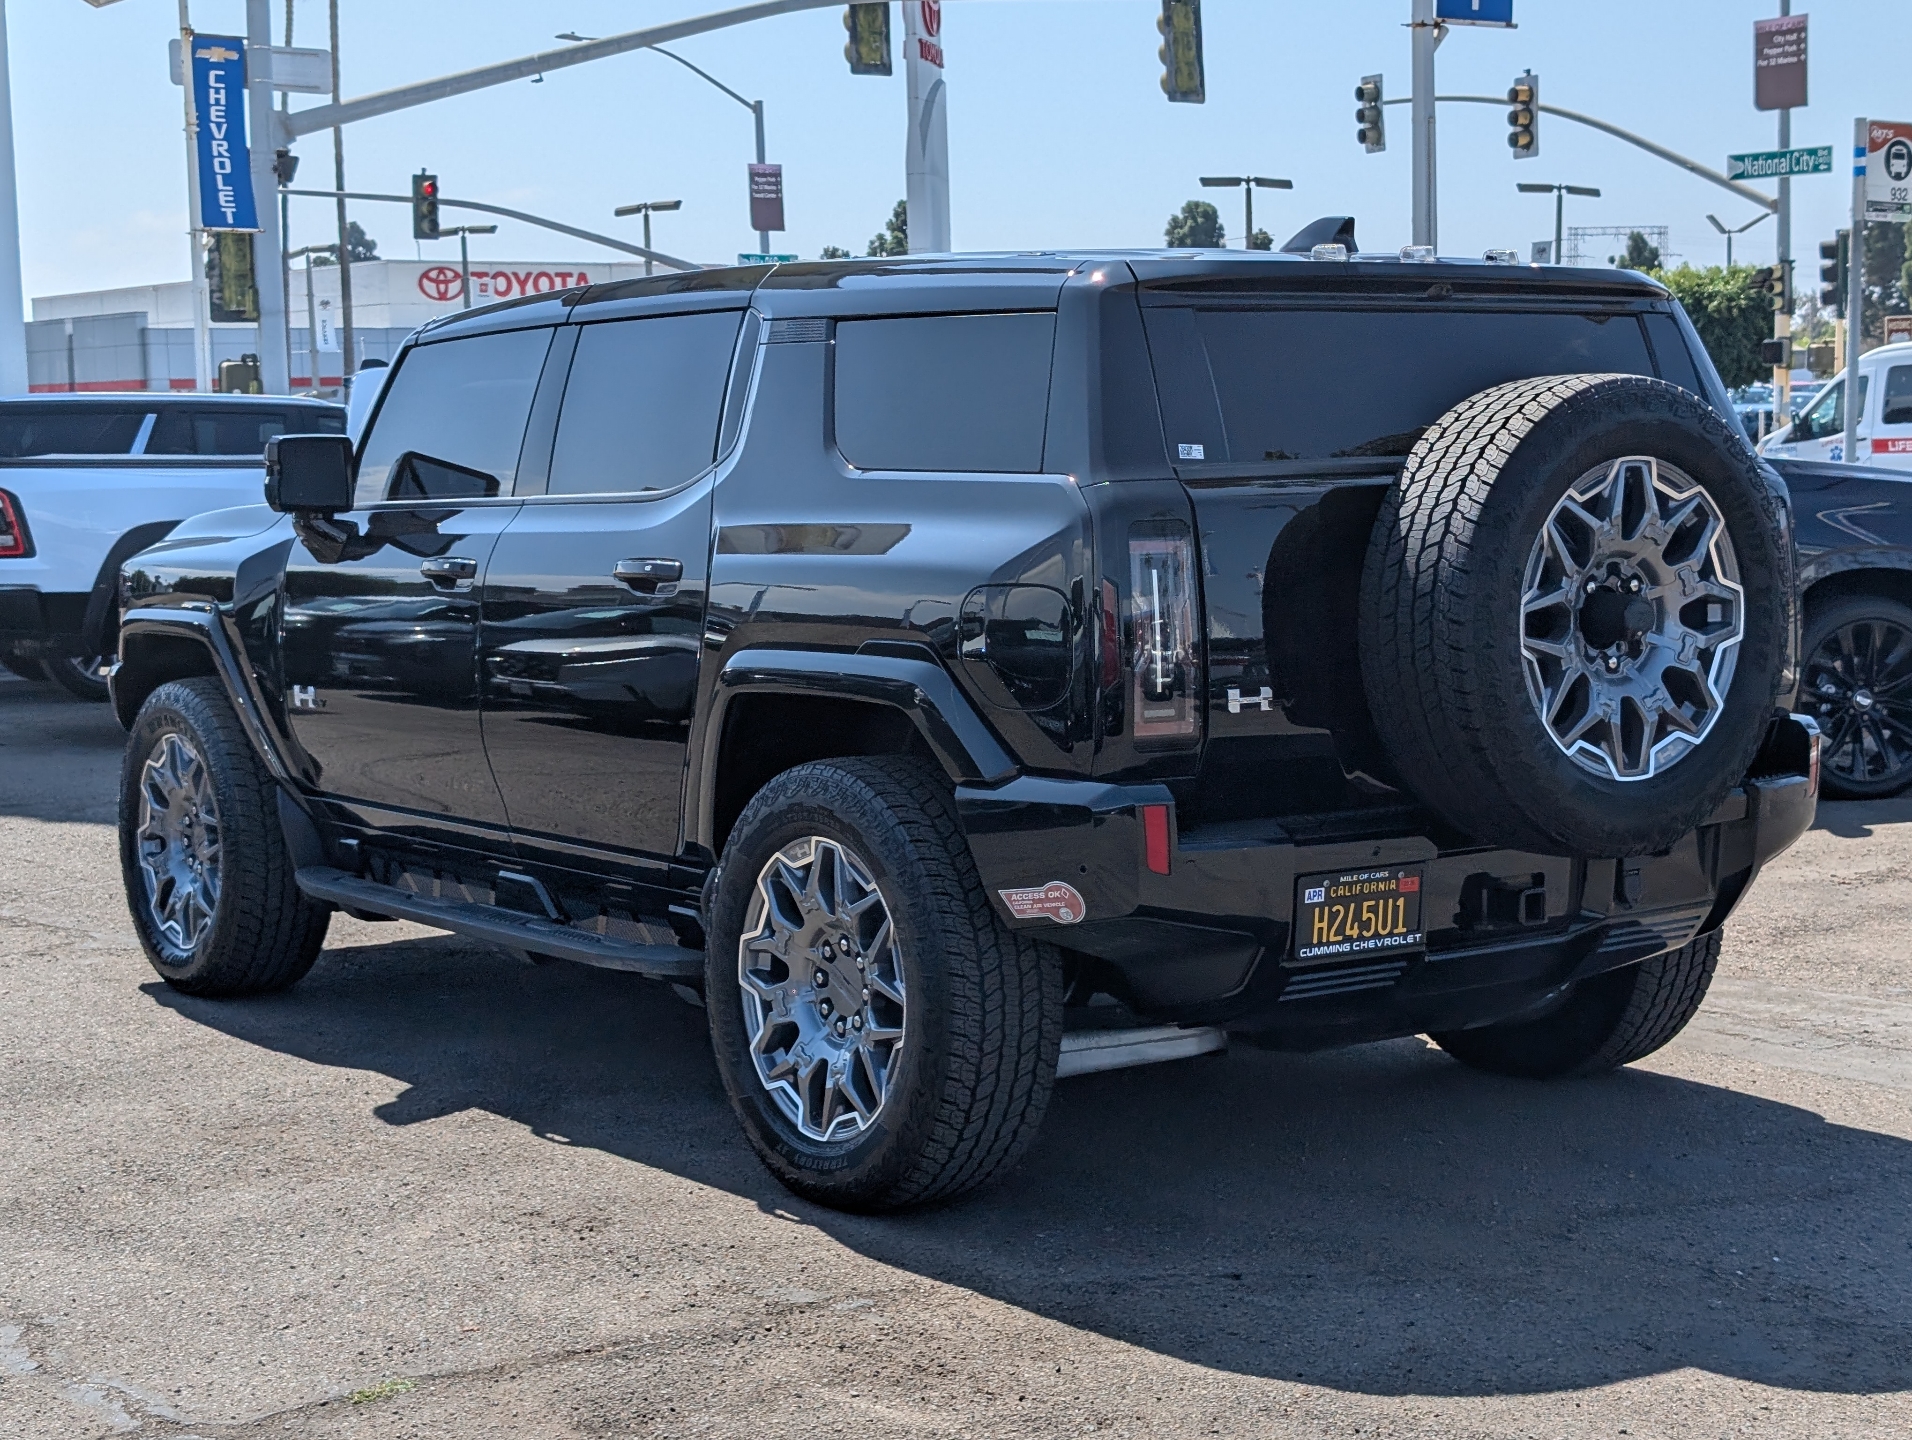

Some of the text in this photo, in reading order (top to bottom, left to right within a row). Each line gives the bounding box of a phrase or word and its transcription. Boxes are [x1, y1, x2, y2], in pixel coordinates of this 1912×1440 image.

[1871, 129, 1895, 139] MTS
[209, 70, 237, 224] CHEVROLET
[1744, 152, 1815, 176] National City
[1890, 187, 1908, 201] 932
[1340, 871, 1389, 883] MILE OF CARS
[1011, 890, 1061, 901] ACCESS OK
[1306, 889, 1323, 902] APR
[1330, 879, 1396, 898] CALIFORNIA
[1312, 897, 1407, 944] H245U1
[1300, 933, 1422, 957] CUMMING CHEVROLET
